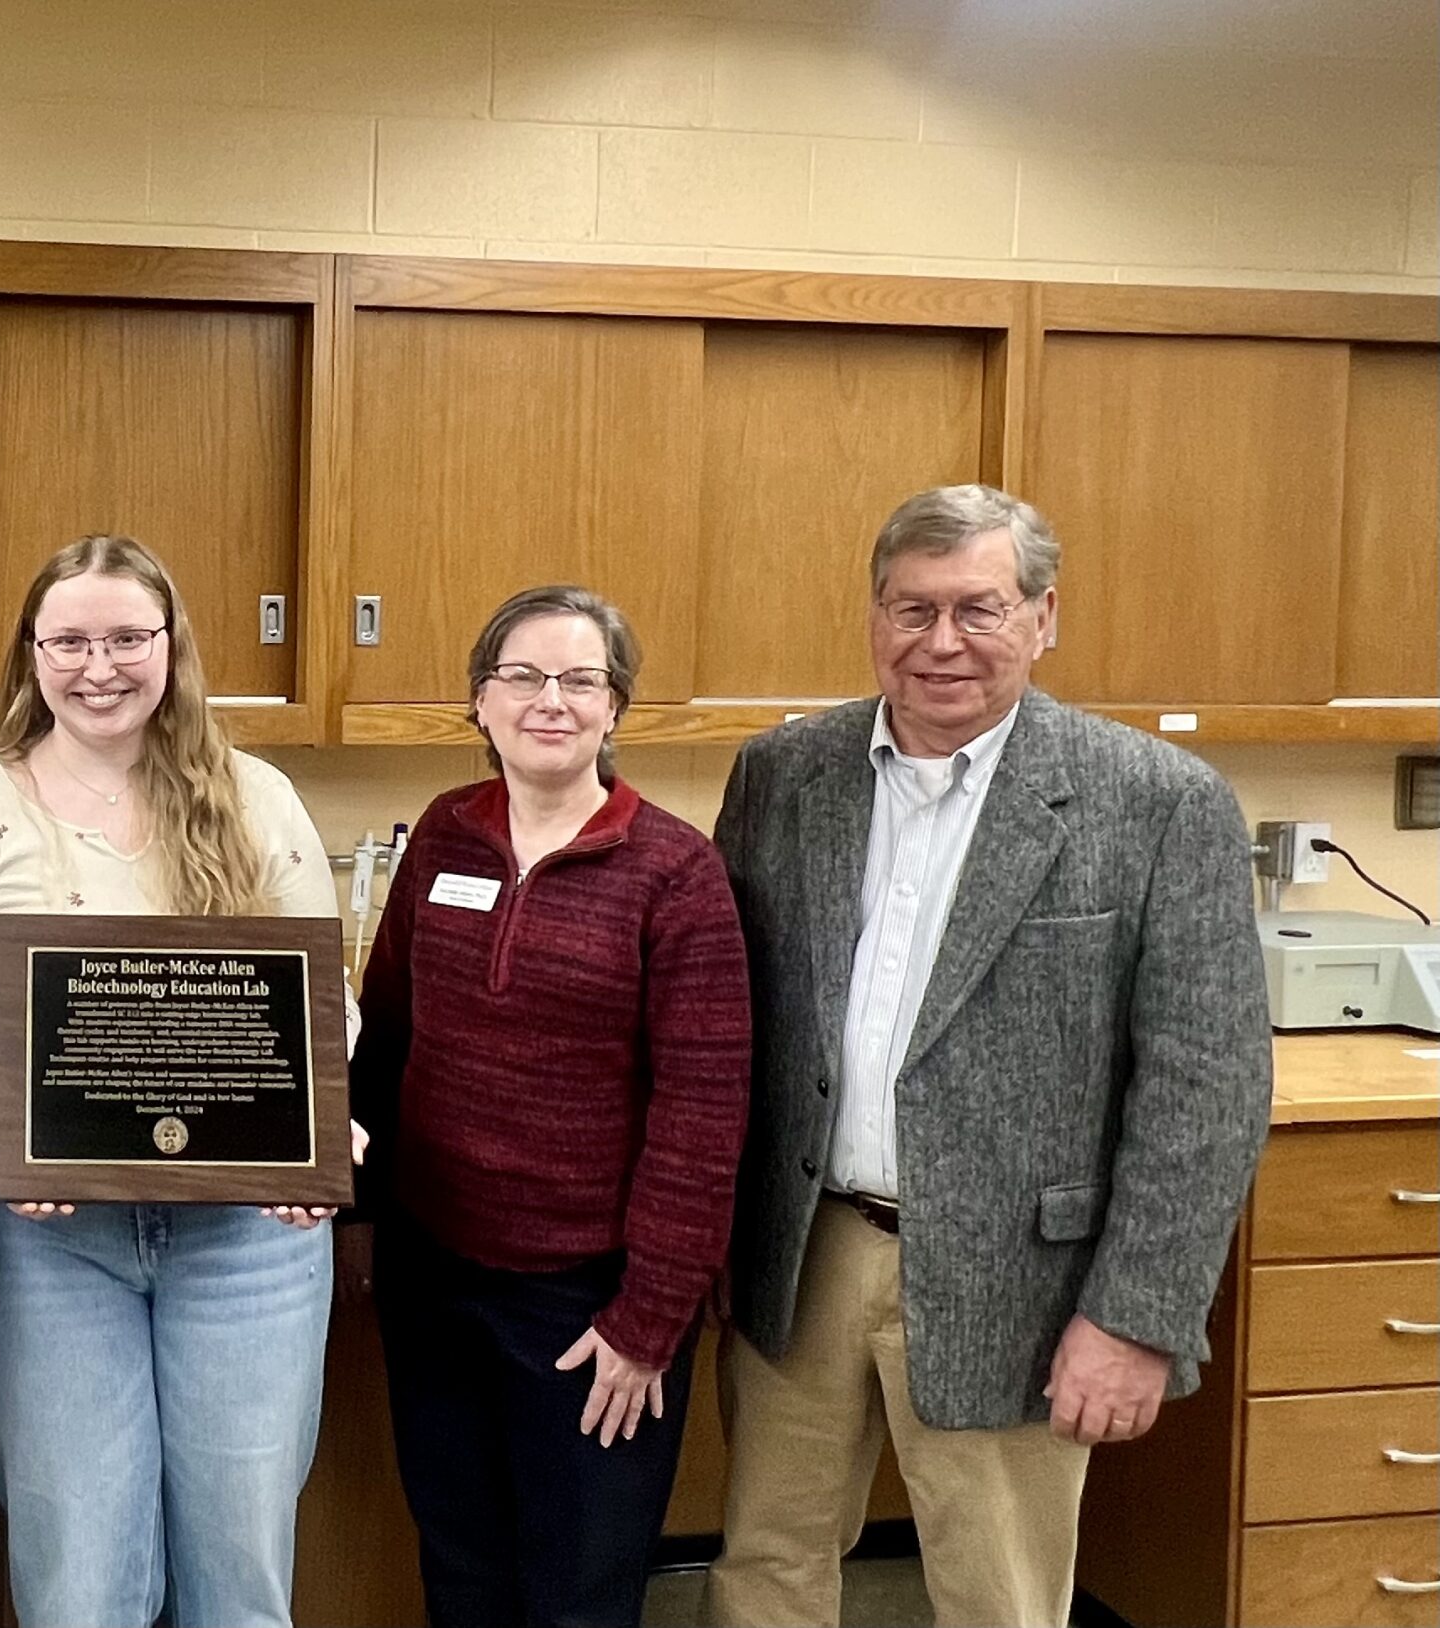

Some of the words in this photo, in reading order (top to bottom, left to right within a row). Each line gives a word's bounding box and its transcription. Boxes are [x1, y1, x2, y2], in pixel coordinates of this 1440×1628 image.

[80, 958, 118, 977] Joyce
[120, 959, 216, 975] Butler-McKee
[218, 960, 256, 976] Allen
[67, 978, 168, 998] Biotechnology
[170, 980, 242, 996] Education
[243, 980, 270, 996] Lab
